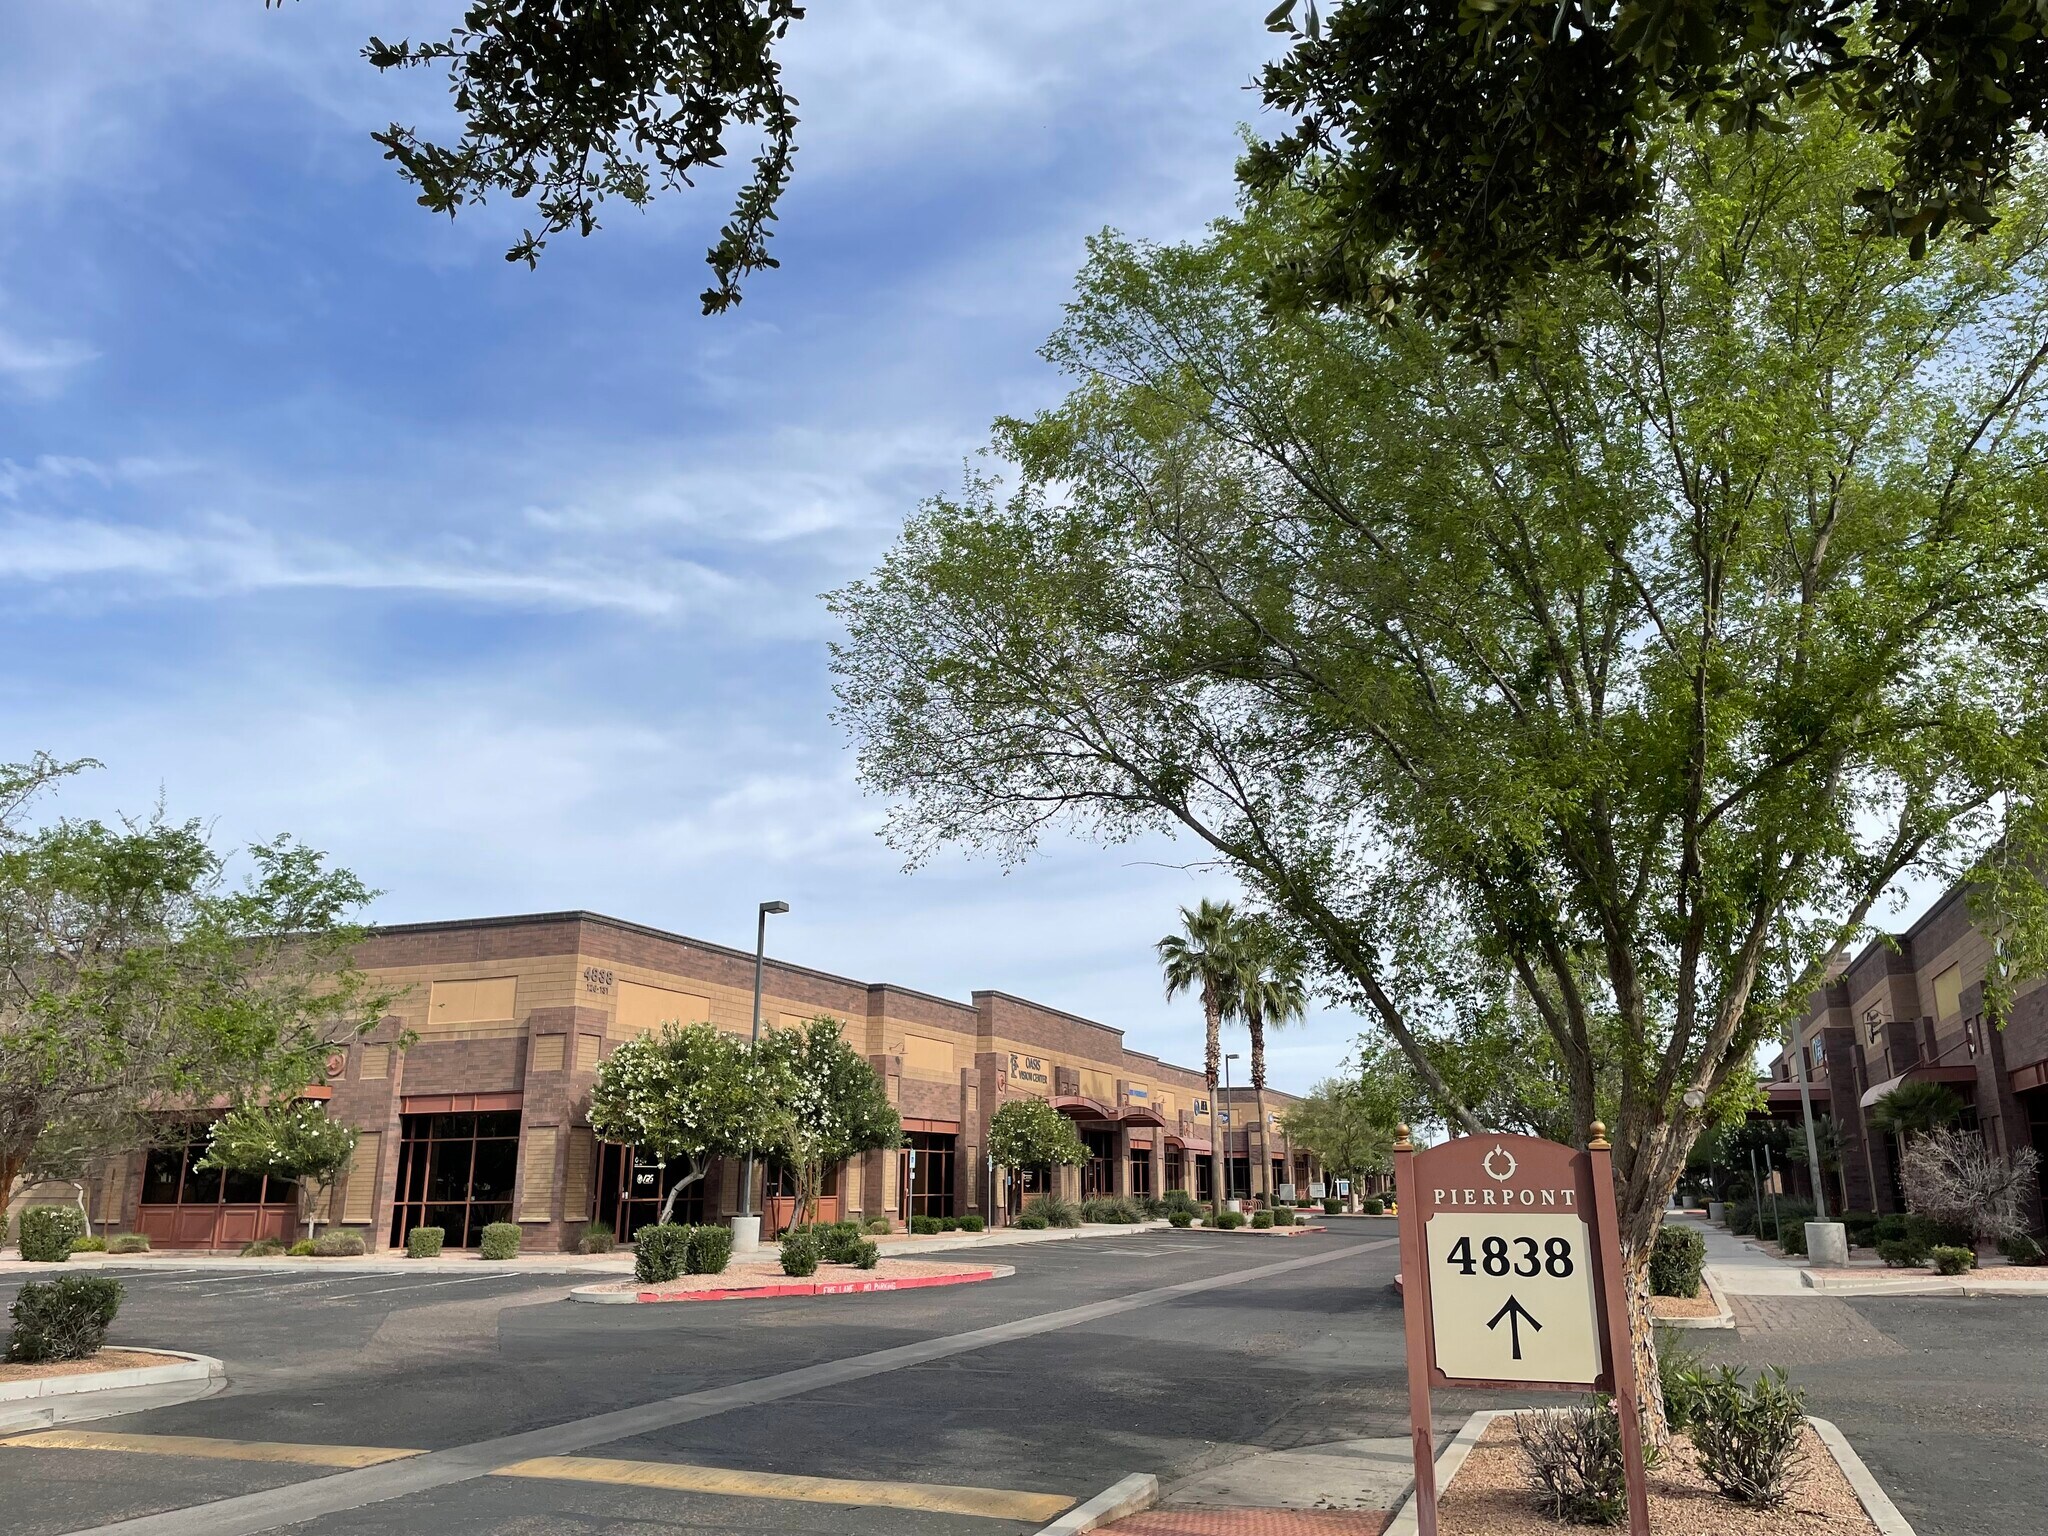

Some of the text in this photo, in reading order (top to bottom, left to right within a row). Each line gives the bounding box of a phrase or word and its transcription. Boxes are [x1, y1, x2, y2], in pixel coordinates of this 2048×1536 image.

[584, 967, 613, 985] 4838
[1025, 1056, 1041, 1071] OASIS
[1018, 1070, 1048, 1085] VISION CENTER
[1433, 1188, 1575, 1206] PIERPONT
[1446, 1236, 1574, 1278] 4838
[823, 1281, 896, 1295] FIRE LANE NO PARKING
